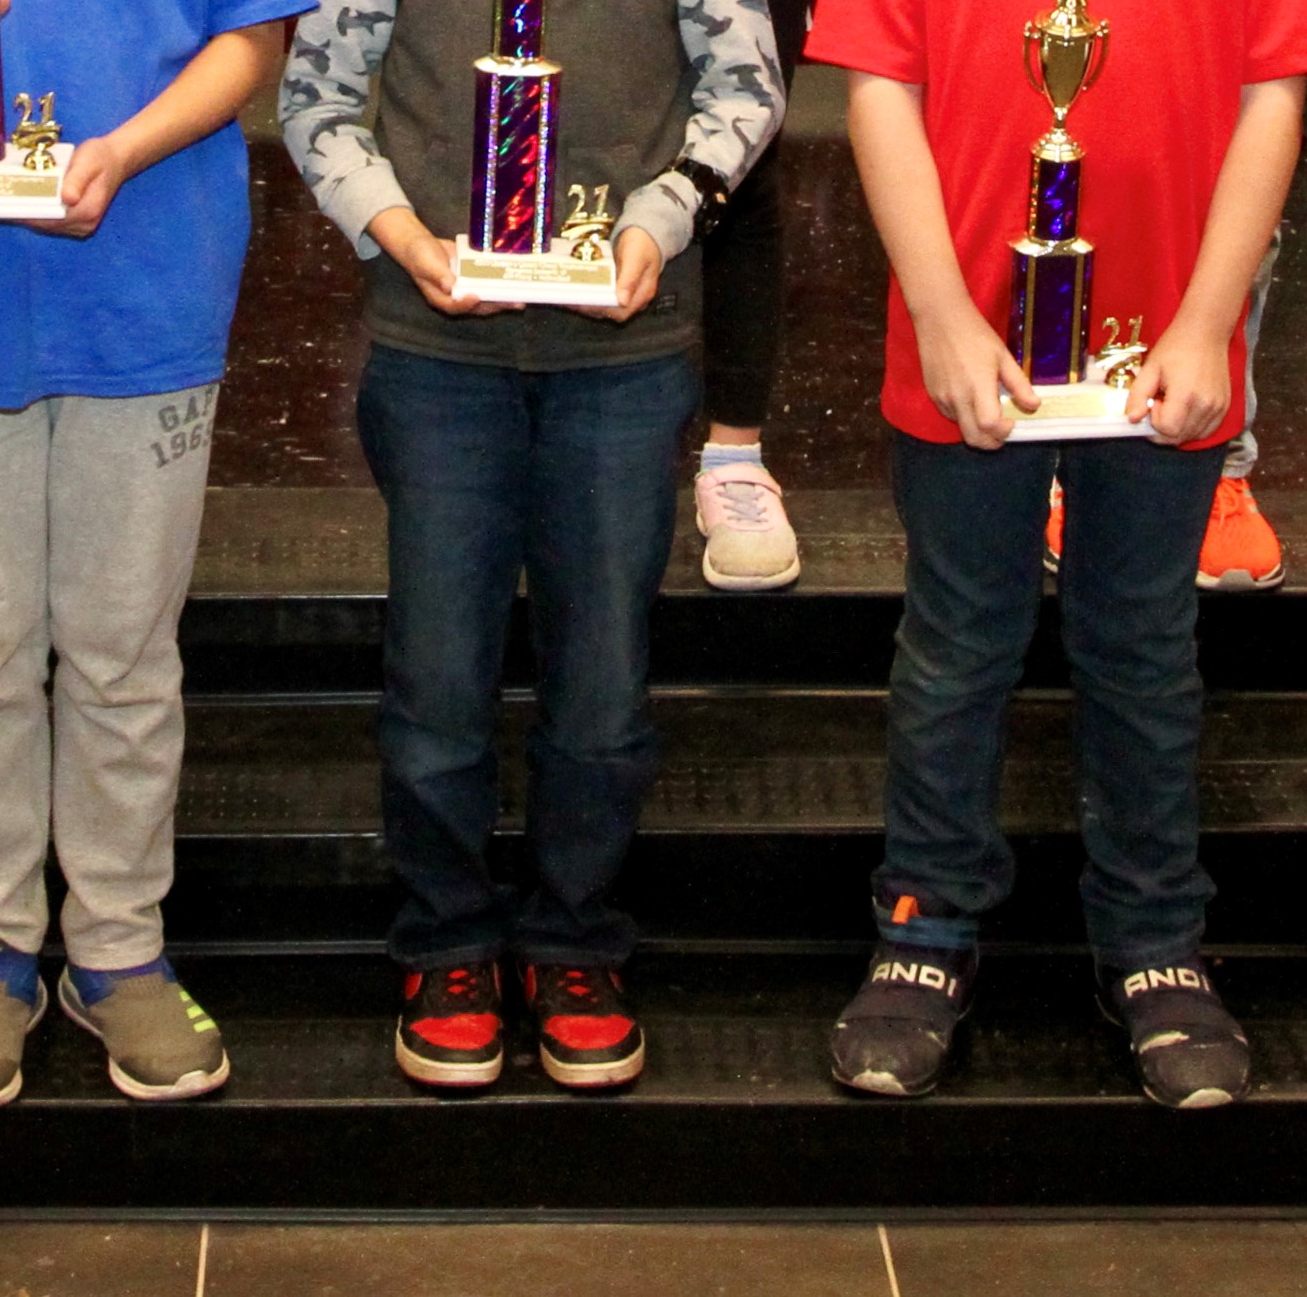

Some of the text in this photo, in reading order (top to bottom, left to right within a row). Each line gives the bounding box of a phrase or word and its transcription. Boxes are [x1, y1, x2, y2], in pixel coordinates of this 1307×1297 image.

[11, 91, 59, 131] 21
[566, 183, 611, 223] 21
[1101, 315, 1146, 355] 21
